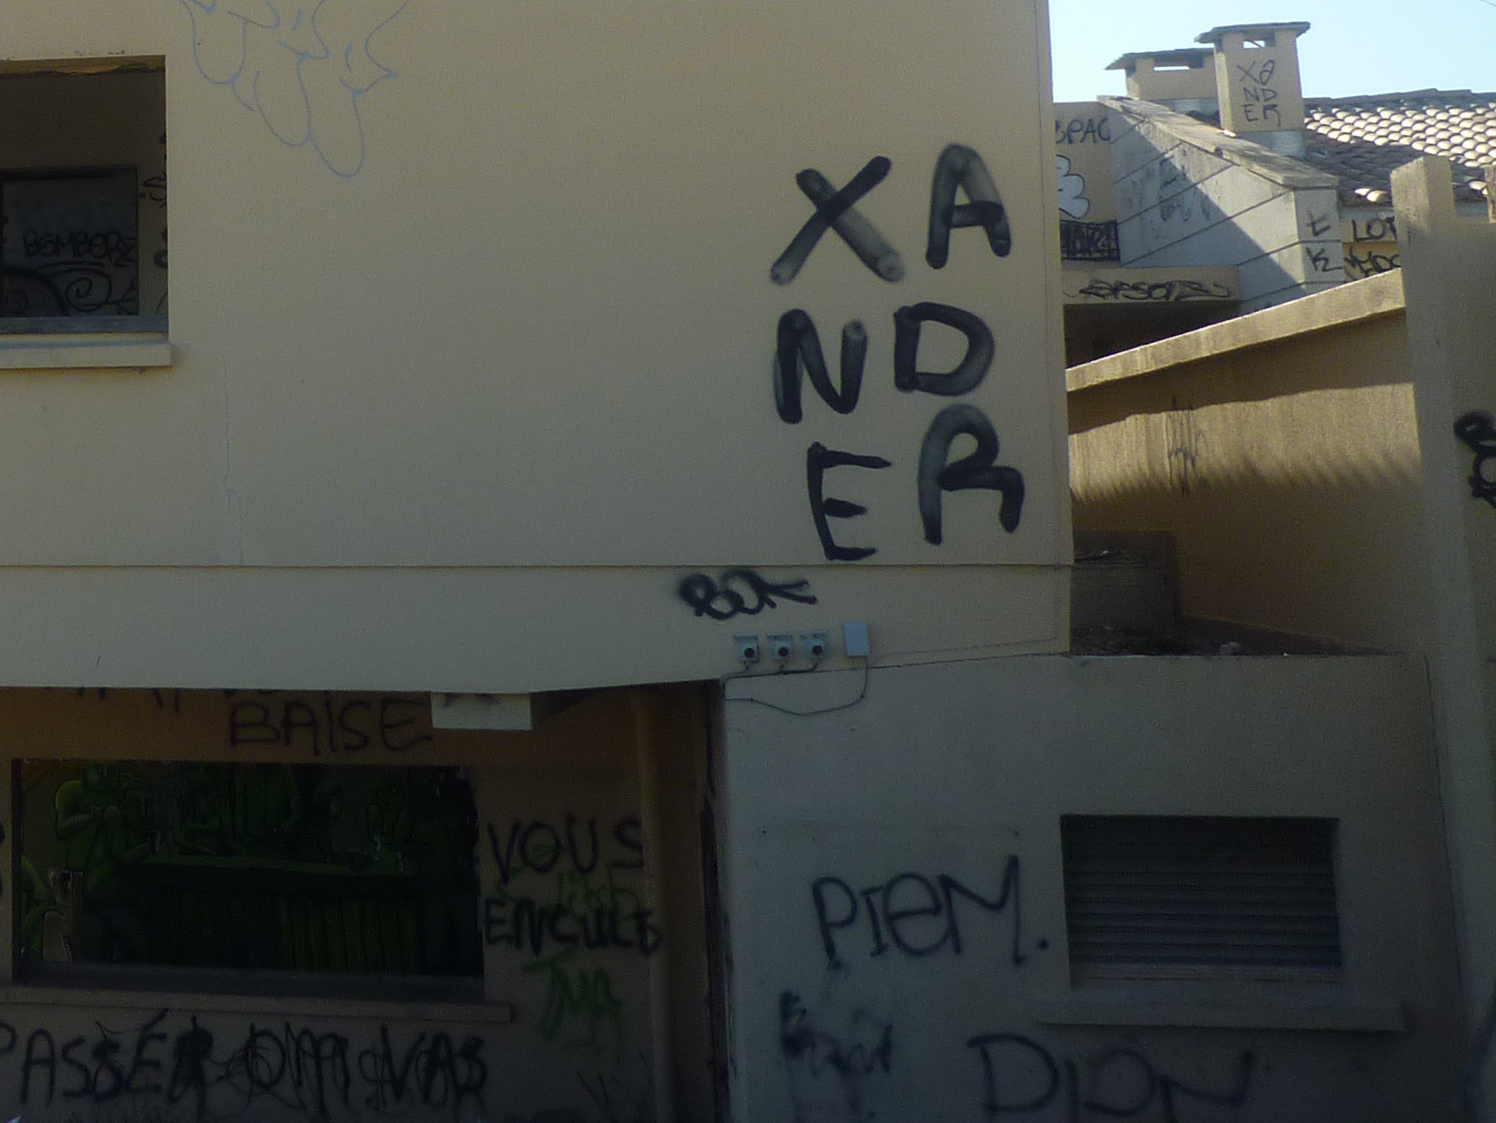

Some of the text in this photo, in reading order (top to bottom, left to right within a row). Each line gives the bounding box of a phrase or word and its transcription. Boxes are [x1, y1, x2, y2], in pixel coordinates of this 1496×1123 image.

[770, 143, 1012, 285] XA
[774, 302, 996, 424] ND
[807, 404, 1026, 560] ER
[230, 698, 435, 758] BAISE
[487, 812, 644, 884] VOUS
